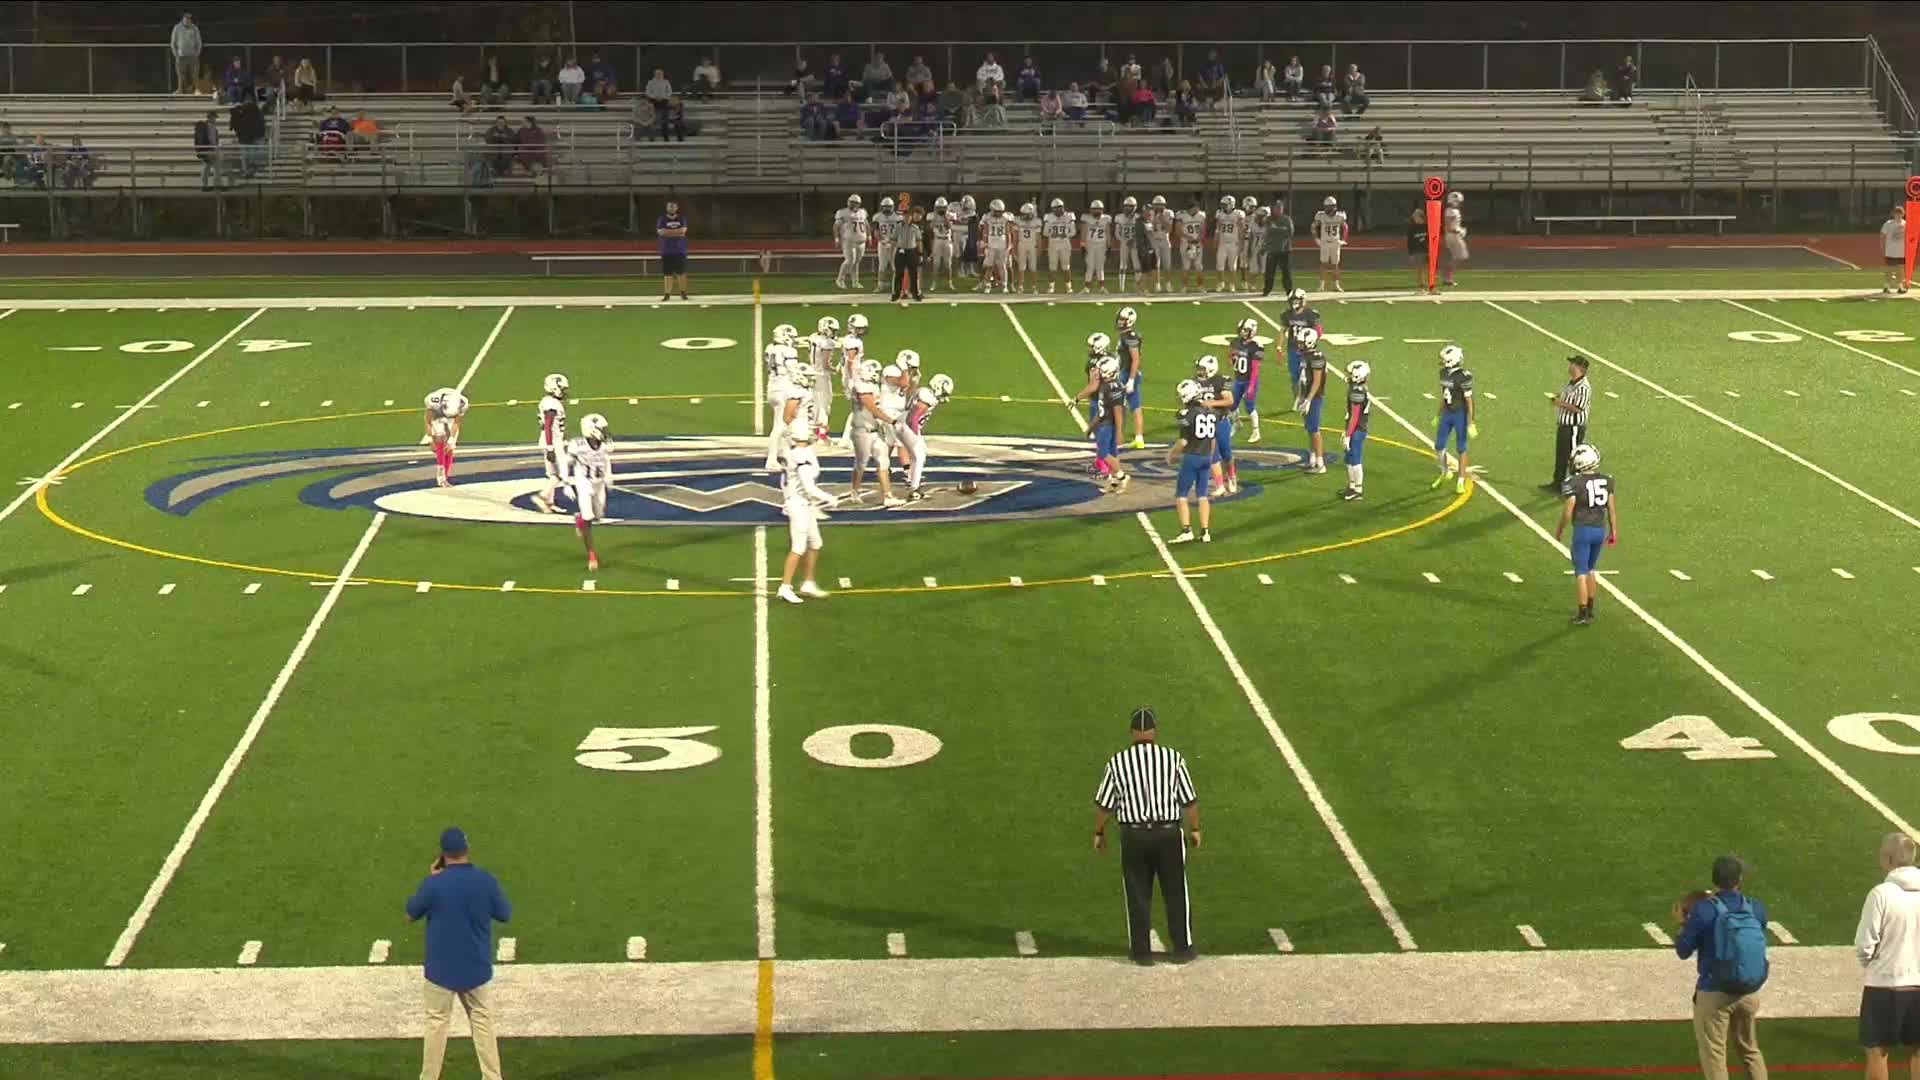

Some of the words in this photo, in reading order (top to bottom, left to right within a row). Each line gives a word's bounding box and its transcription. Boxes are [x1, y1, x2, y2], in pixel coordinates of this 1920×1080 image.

[1089, 228, 1105, 239] 72
[1195, 413, 1217, 439] 66
[1585, 478, 1608, 508] 15
